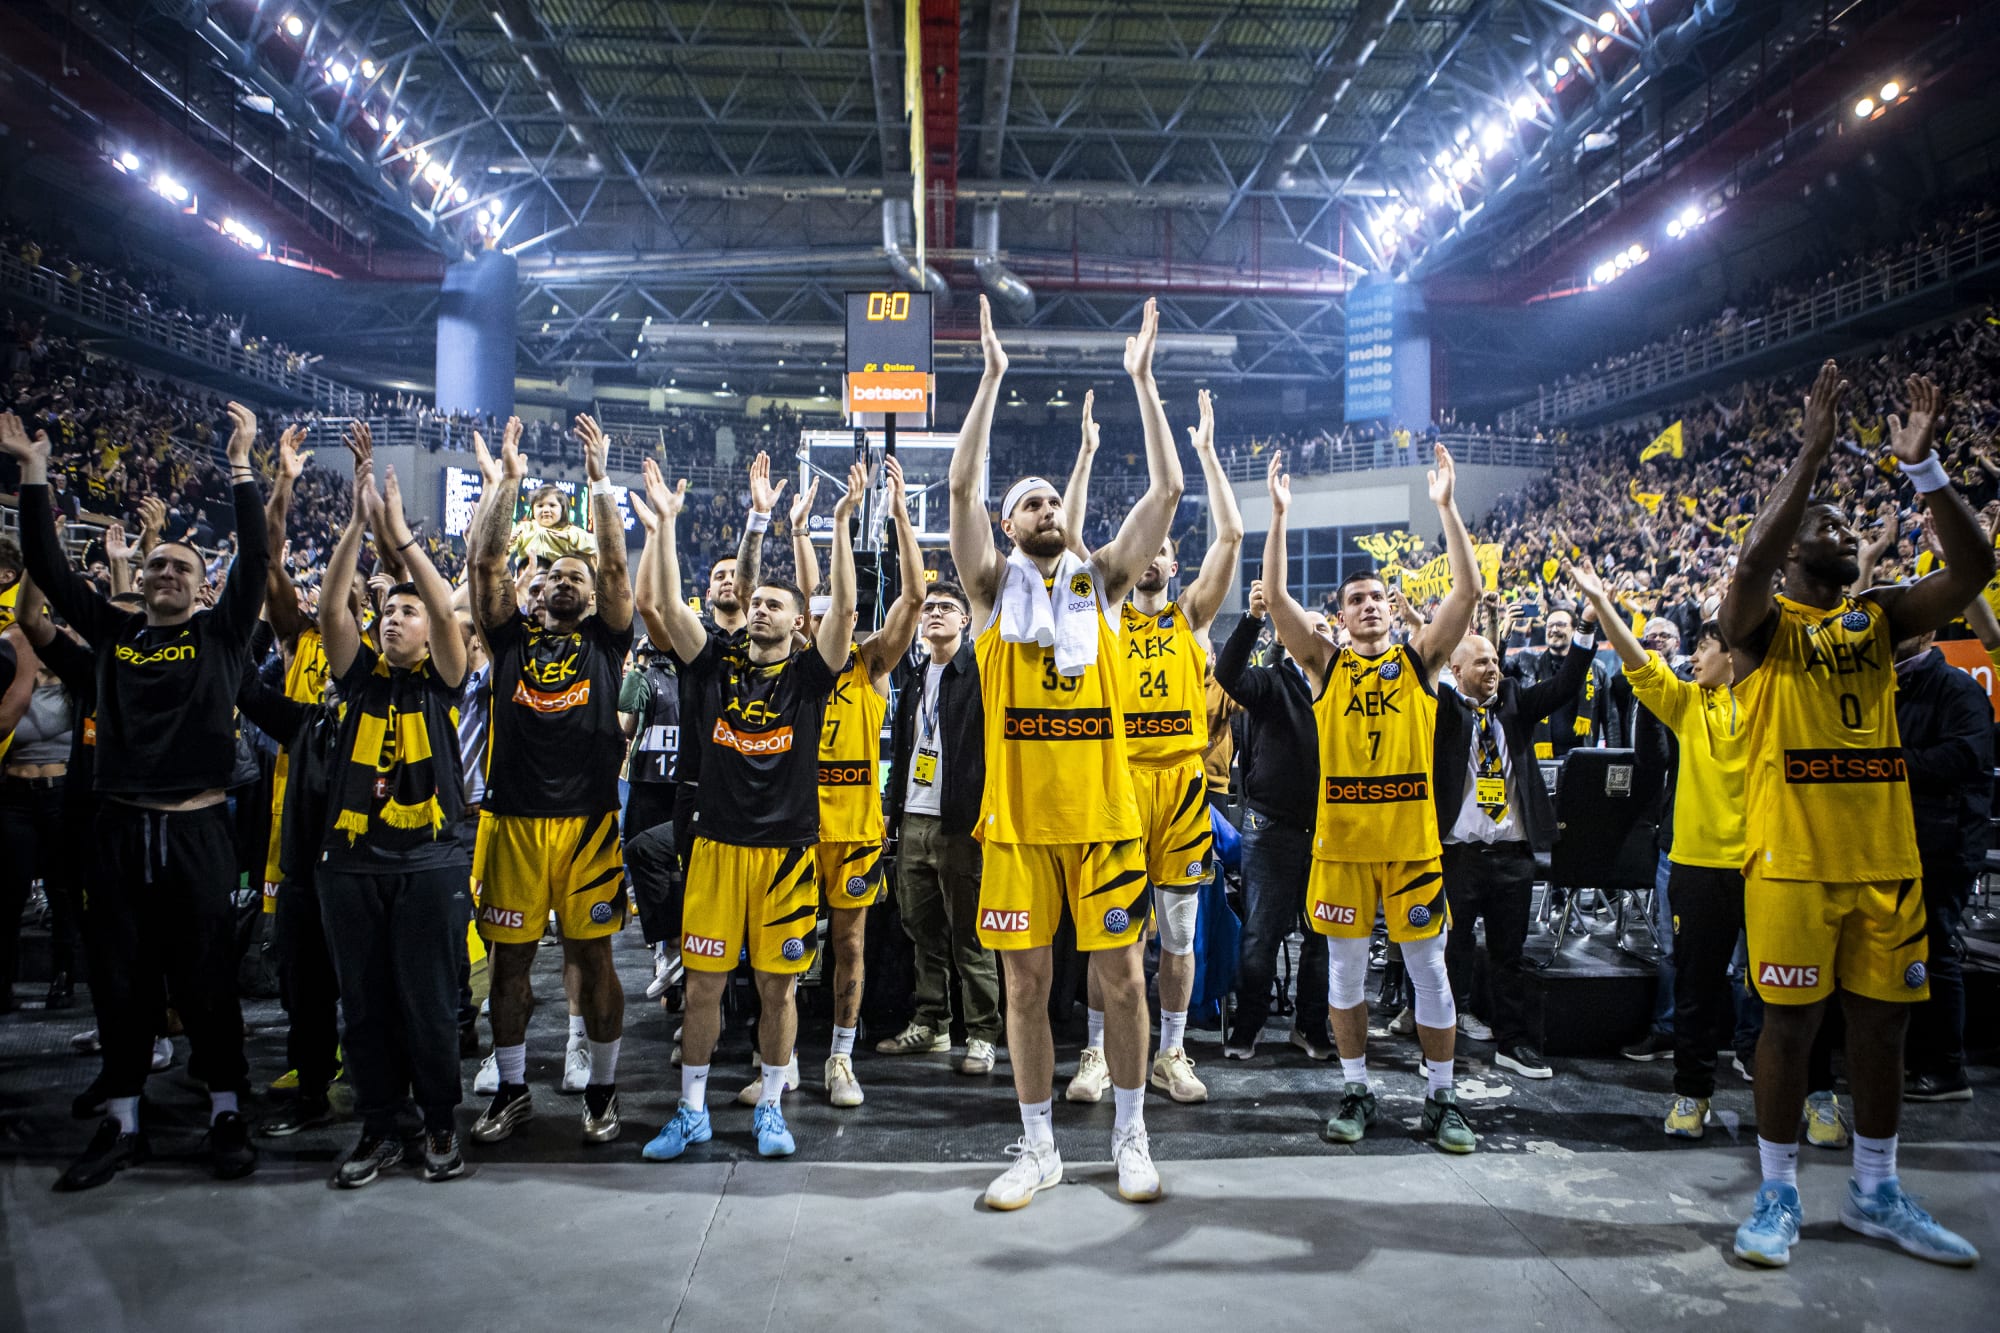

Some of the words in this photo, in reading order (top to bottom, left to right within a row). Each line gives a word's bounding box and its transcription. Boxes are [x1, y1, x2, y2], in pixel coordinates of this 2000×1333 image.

[853, 386, 923, 401] betsson
[1127, 636, 1176, 660] AEK
[1804, 639, 1880, 675] AEK
[524, 653, 578, 683] AEK
[1139, 670, 1168, 698] 24
[1344, 688, 1401, 717] AEK
[1840, 693, 1862, 730] 0
[826, 720, 841, 747] 7
[1005, 712, 1112, 737] betsson
[1125, 716, 1191, 734] etsso
[1368, 731, 1381, 761] 7
[818, 766, 871, 783] sson
[1785, 754, 1906, 778] betsson
[1326, 780, 1428, 801] betsson
[483, 906, 523, 928] AVIS
[982, 911, 1029, 930] AVIS
[1315, 903, 1355, 924] AVIS
[685, 935, 725, 956] AVIS
[1761, 965, 1818, 986] AVIS
